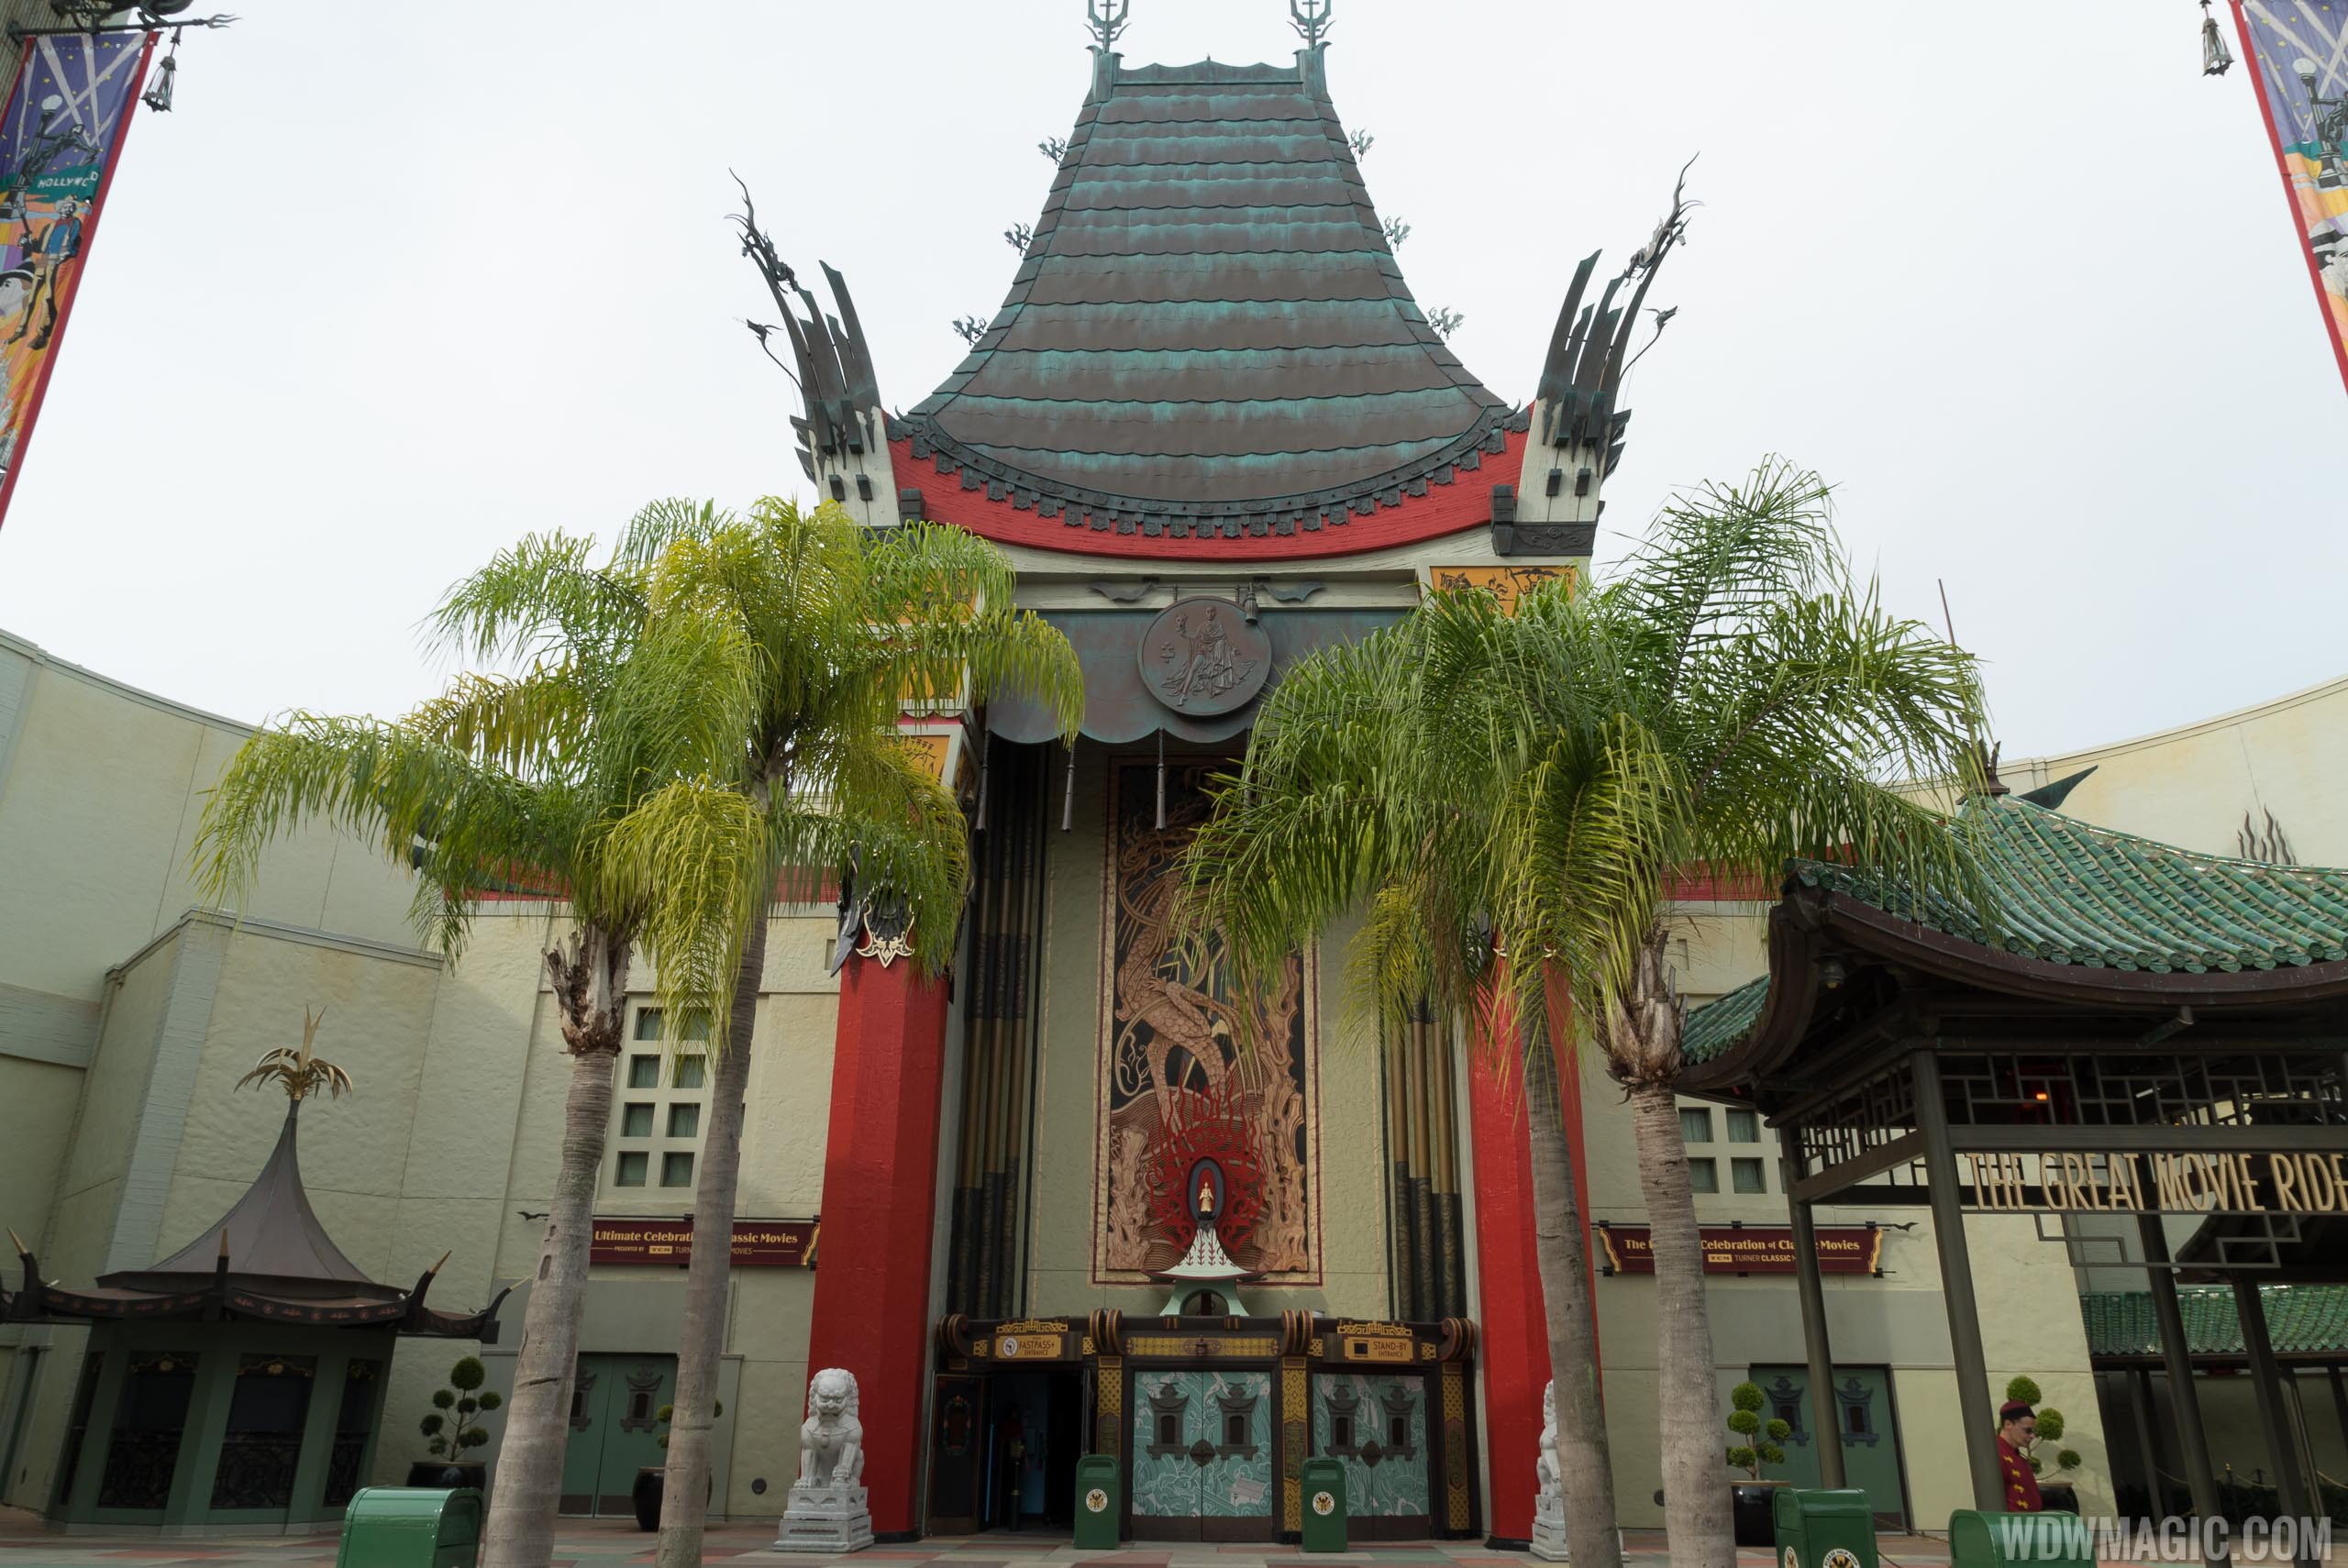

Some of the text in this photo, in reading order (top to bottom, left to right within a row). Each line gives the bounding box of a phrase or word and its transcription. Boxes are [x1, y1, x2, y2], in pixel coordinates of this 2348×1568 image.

[1966, 1152, 2032, 1210] THE
[2040, 1152, 2145, 1210] GREAT
[2154, 1152, 2265, 1211] MOVIE
[594, 1231, 641, 1242] Ultimate
[644, 1231, 693, 1242] Celebrati
[760, 1232, 798, 1243] Movies
[1624, 1239, 1646, 1250] The
[1700, 1240, 1766, 1250] Celebration
[1821, 1240, 1860, 1251] Movies
[1734, 1254, 1760, 1263] TURNER
[1761, 1254, 1790, 1263] CLASSIC
[1373, 1341, 1408, 1351] STAND-BY
